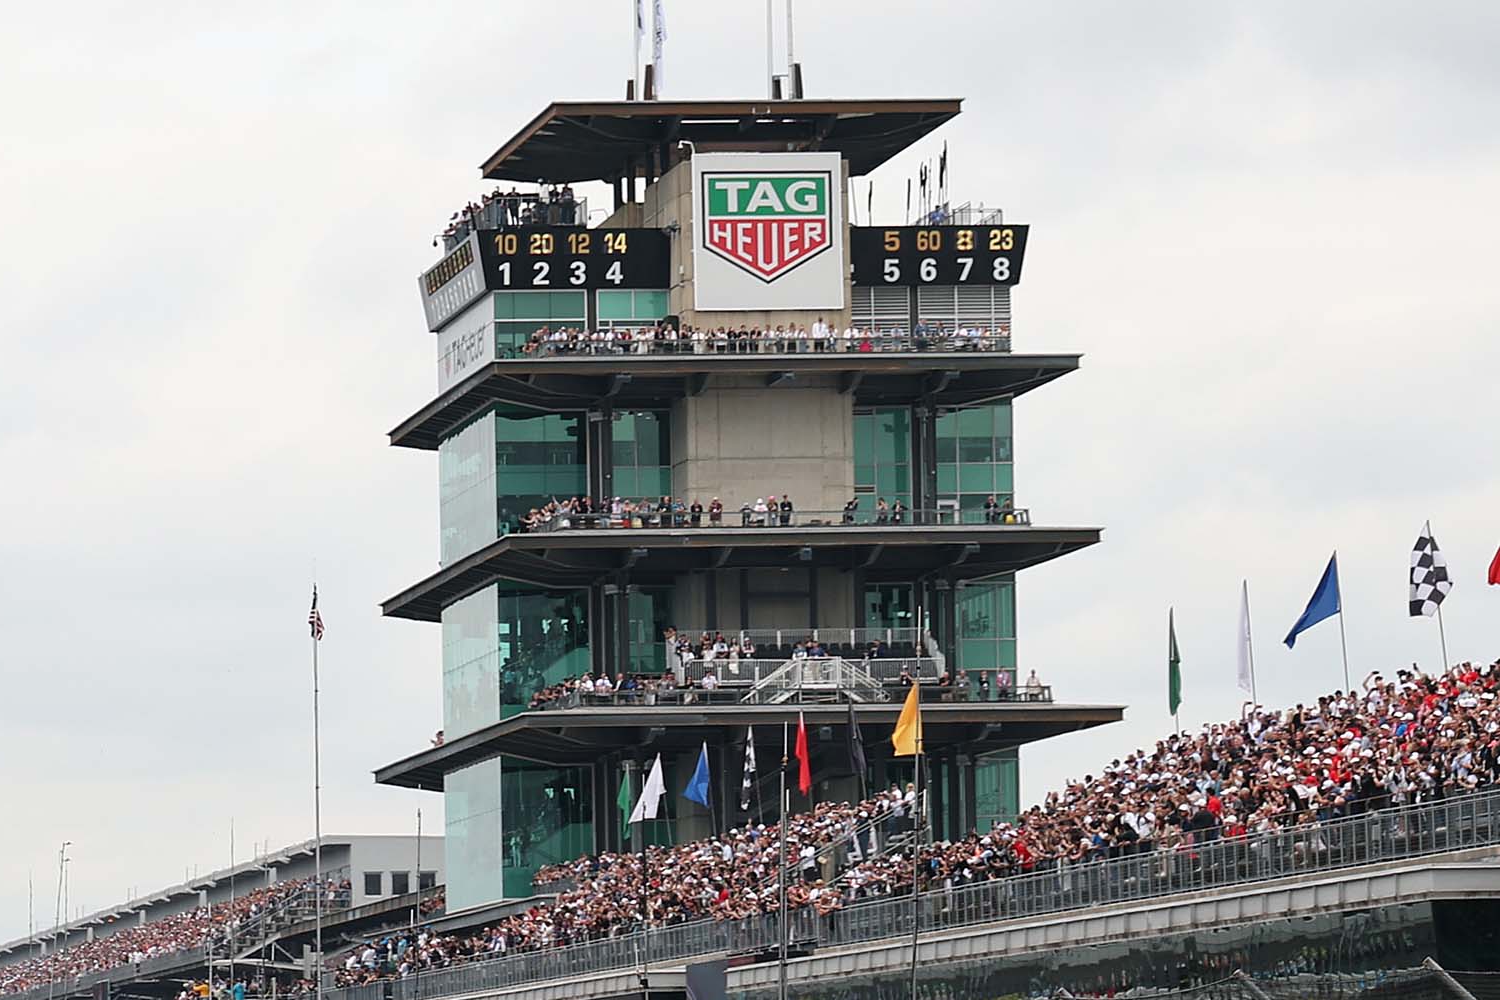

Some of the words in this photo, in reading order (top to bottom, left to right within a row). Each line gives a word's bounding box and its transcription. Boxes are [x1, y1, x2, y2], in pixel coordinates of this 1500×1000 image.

[715, 181, 818, 212] TAG
[495, 234, 517, 255] 10
[530, 233, 554, 254] 20
[568, 233, 590, 254] 12
[604, 232, 628, 254] 14
[713, 223, 822, 271] HEUER
[884, 231, 900, 252] 5
[916, 230, 941, 251] 60
[989, 229, 1014, 250] 23
[499, 262, 511, 286] 1
[532, 262, 550, 286] 2
[569, 261, 587, 285] 3
[605, 261, 624, 285] 4
[883, 258, 900, 282] 5
[920, 258, 937, 282] 6
[957, 258, 974, 281] 7
[993, 257, 1010, 281] 8
